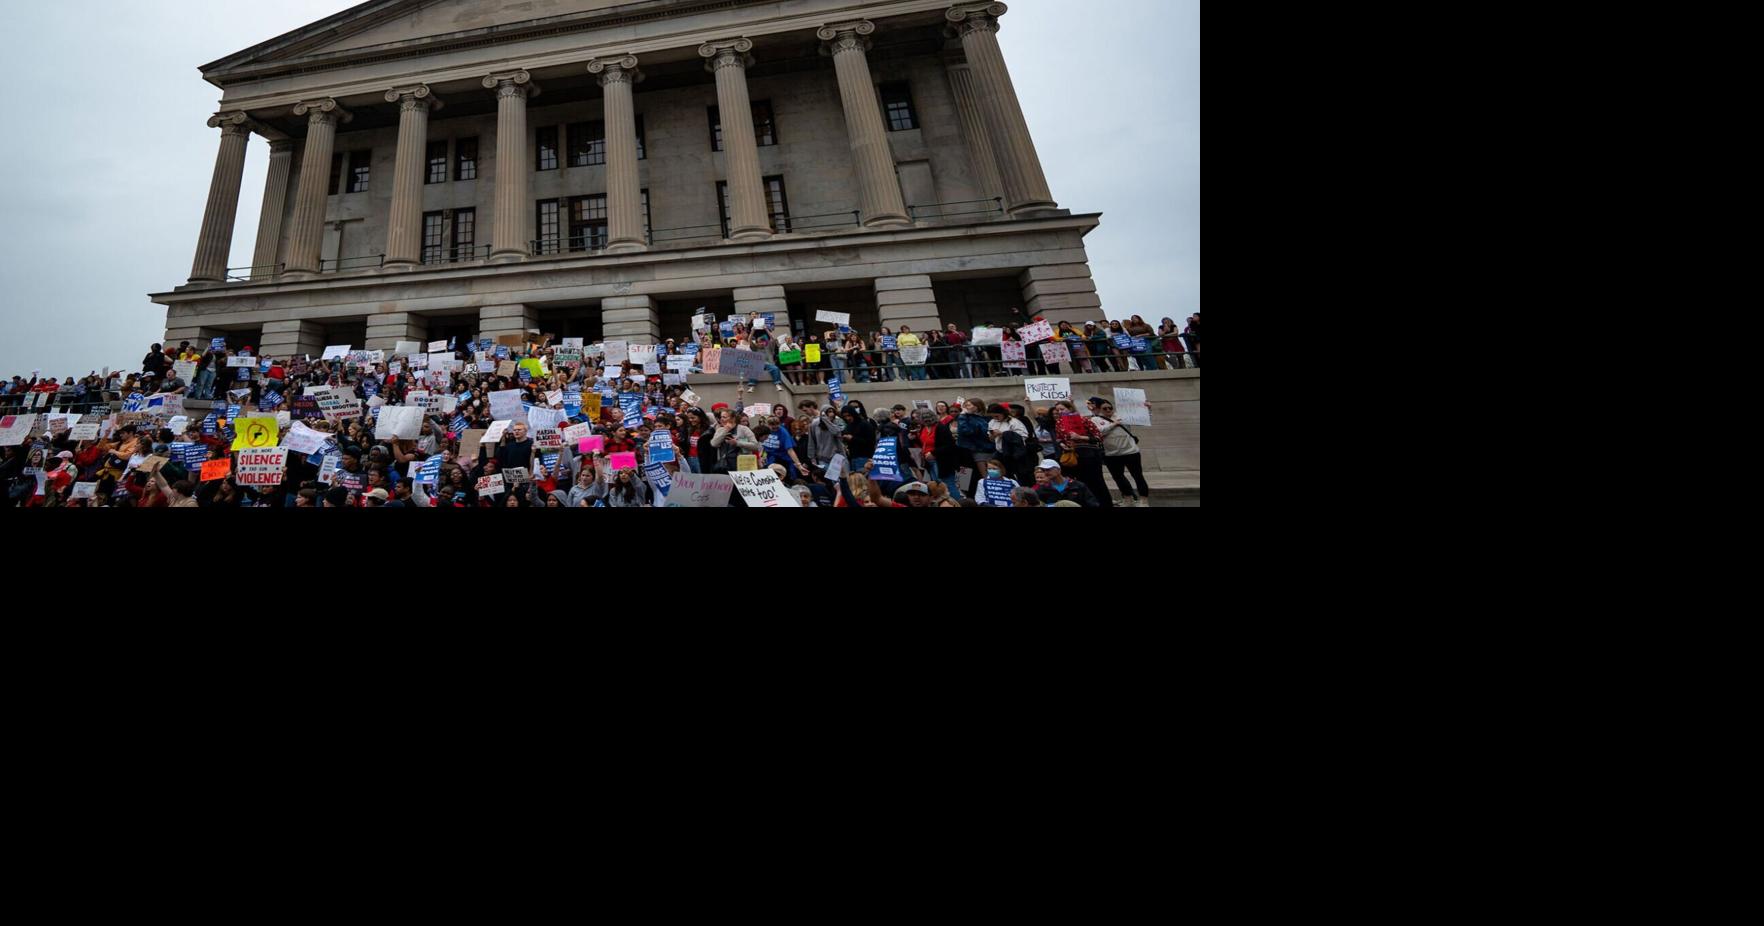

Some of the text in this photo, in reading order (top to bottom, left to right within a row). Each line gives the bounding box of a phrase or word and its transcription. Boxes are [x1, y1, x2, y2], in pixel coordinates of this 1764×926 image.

[1027, 383, 1058, 393] PROTECT
[1040, 391, 1069, 400] KIDS!
[661, 441, 672, 449] US
[240, 454, 283, 466] SILENCE
[237, 472, 282, 484] VIOLENCE
[656, 476, 672, 488] US
[756, 486, 779, 500] too!
